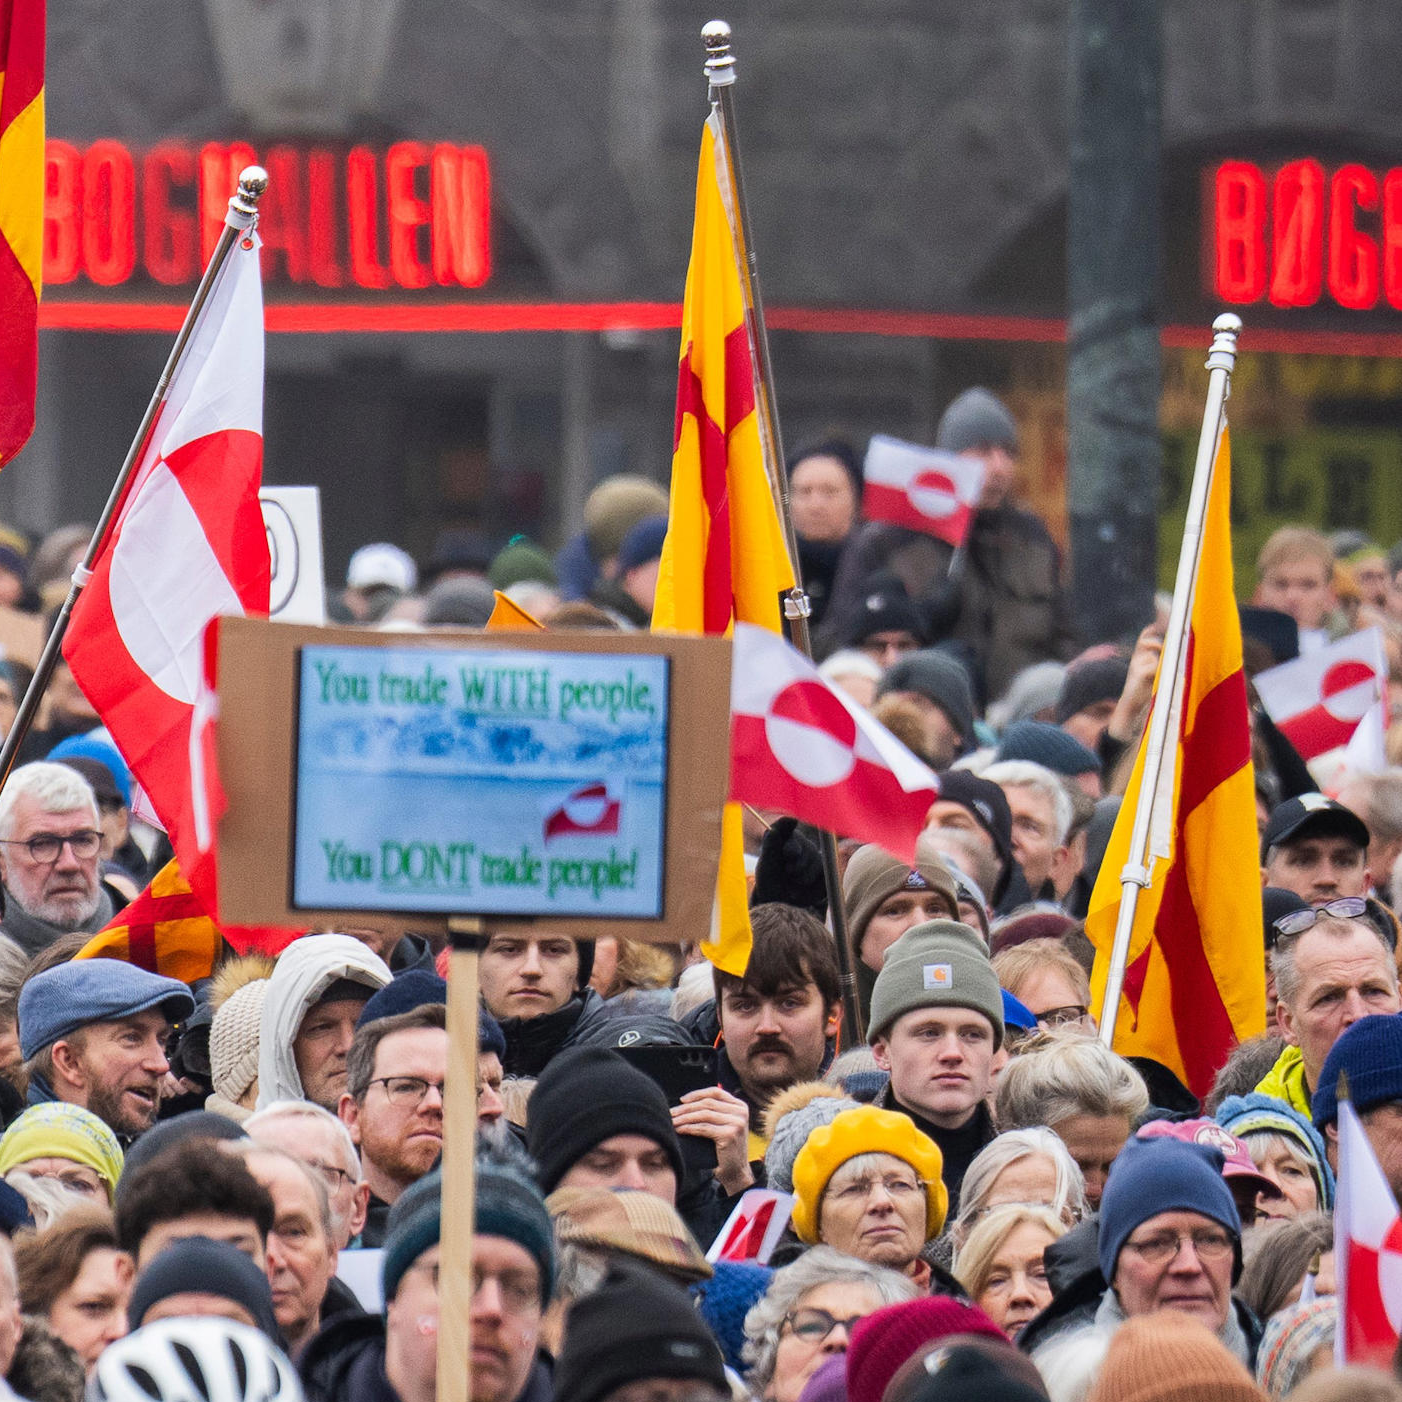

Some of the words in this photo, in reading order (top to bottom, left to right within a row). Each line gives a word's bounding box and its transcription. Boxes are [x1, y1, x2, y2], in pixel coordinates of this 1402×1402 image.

[314, 658, 370, 704] You
[378, 662, 448, 705] trade
[459, 665, 550, 710] WITH
[559, 670, 657, 722] people,
[320, 838, 373, 883] You
[480, 845, 542, 886] trade
[547, 846, 639, 900] people!
